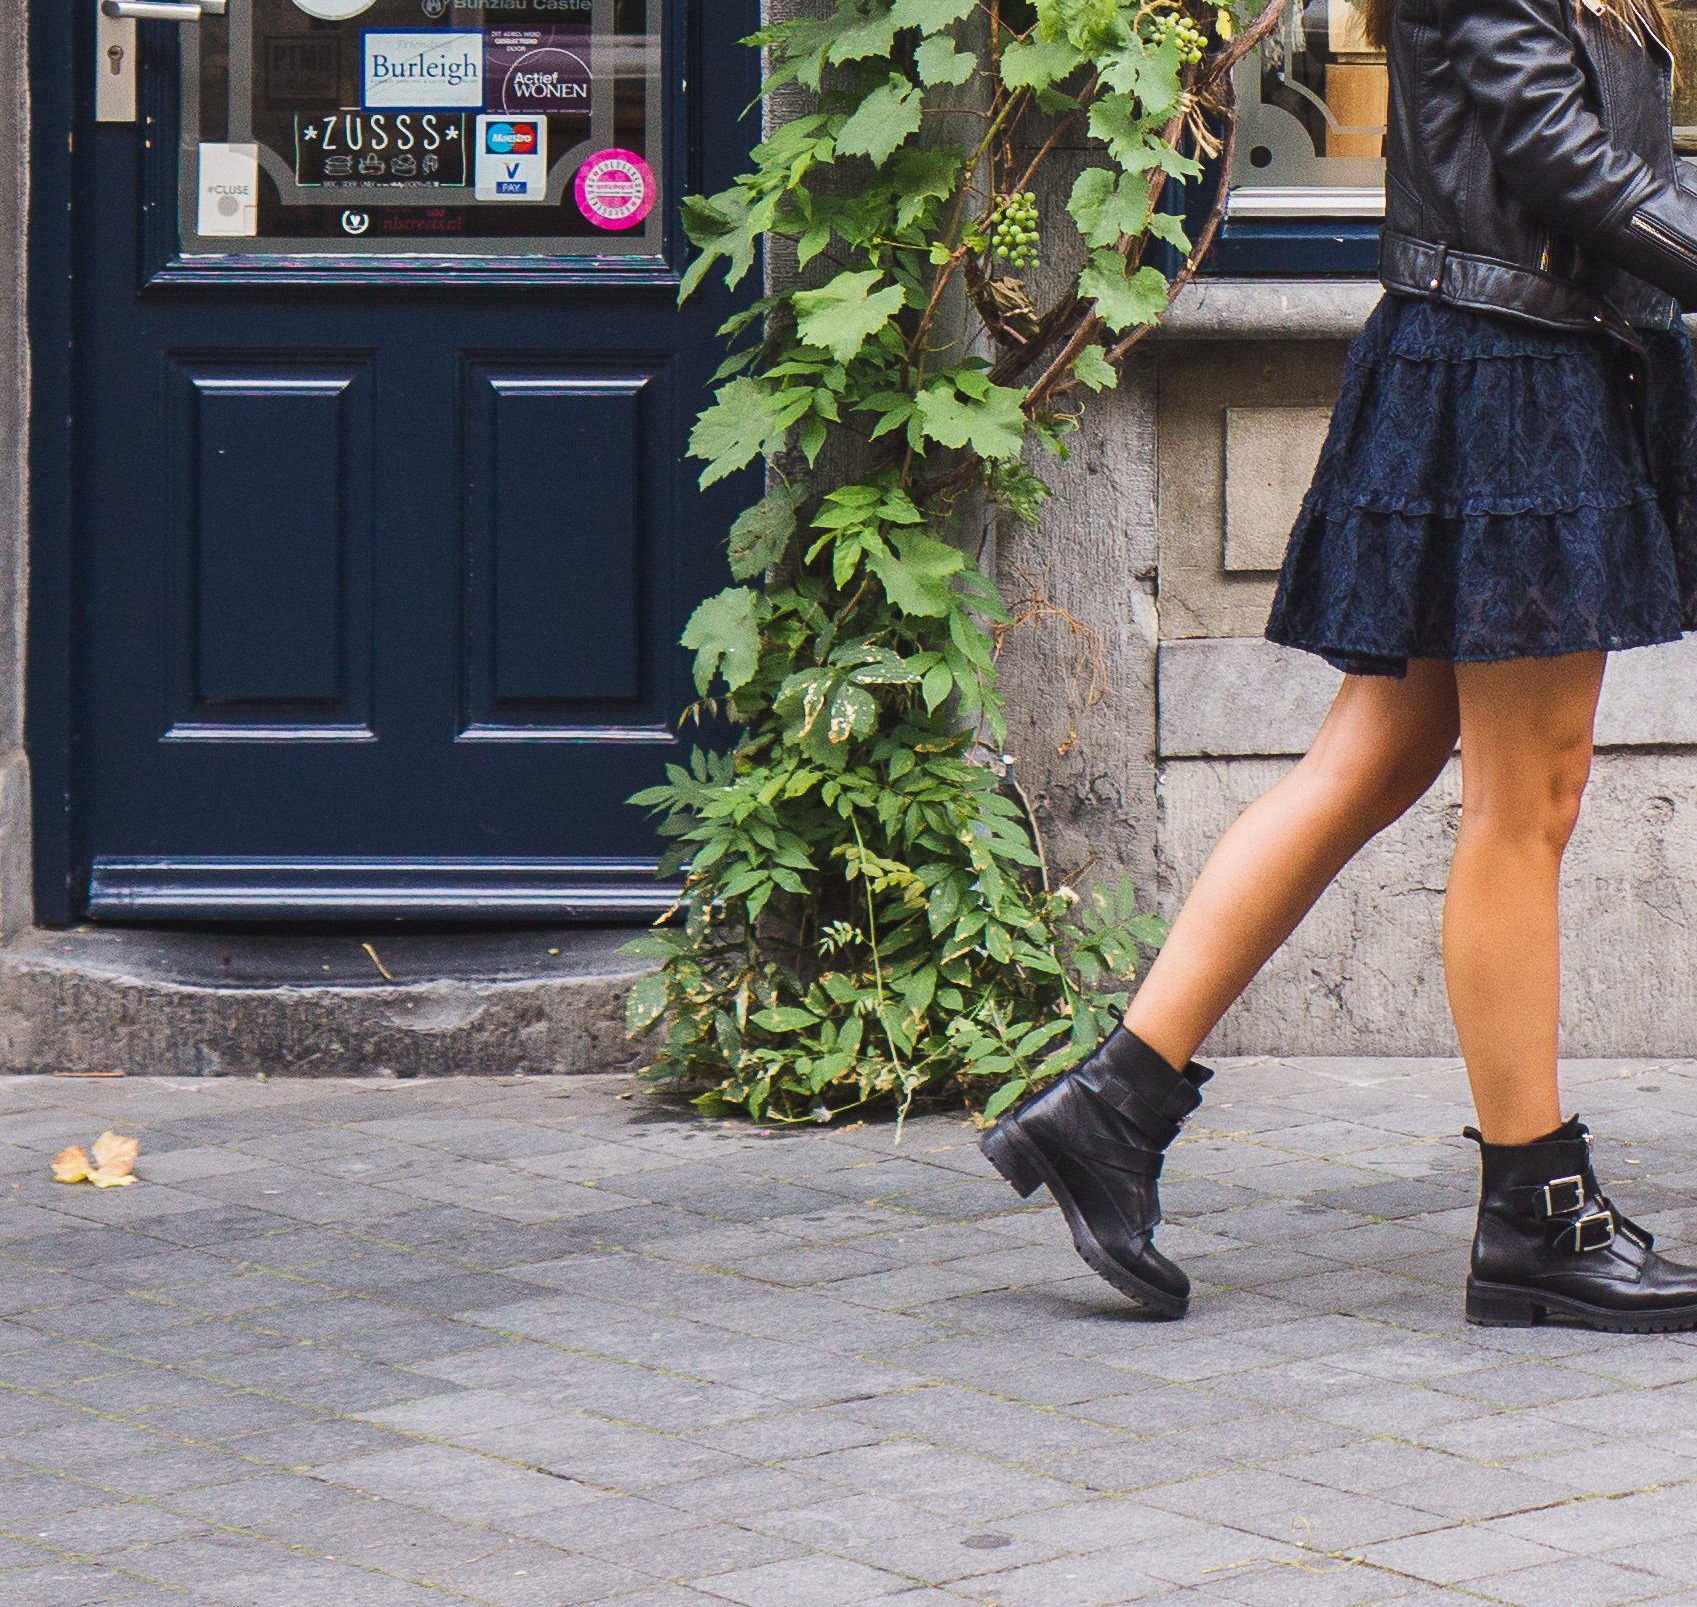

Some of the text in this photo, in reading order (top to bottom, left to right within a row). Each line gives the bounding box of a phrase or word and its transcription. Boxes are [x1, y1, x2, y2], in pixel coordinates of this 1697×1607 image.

[372, 53, 478, 85] Burleigh
[514, 72, 559, 84] Actief
[514, 84, 587, 97] WONEN
[502, 183, 520, 192] PAY
